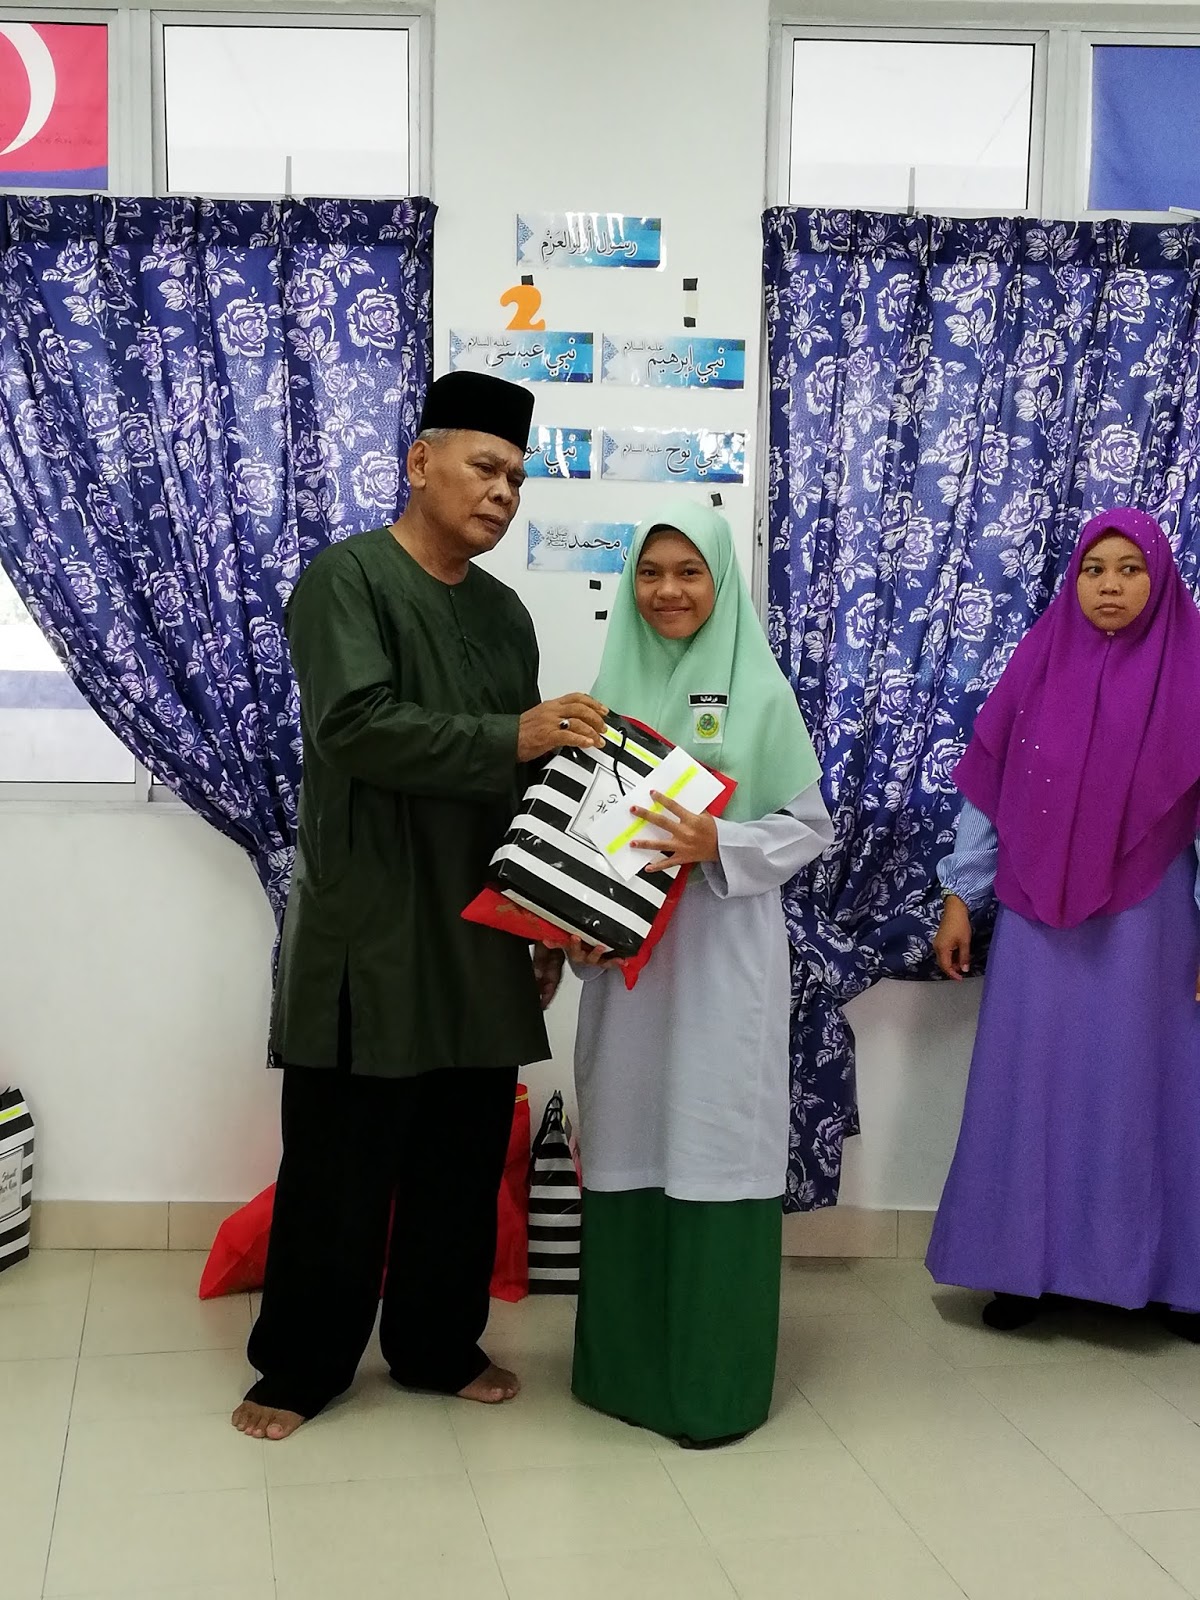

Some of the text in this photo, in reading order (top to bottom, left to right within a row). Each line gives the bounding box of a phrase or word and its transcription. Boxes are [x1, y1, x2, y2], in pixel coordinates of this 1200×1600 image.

[499, 285, 546, 331] 2
[485, 344, 544, 368] عيسى
[546, 338, 576, 376] نبي
[696, 347, 725, 382] نبي
[666, 439, 691, 474] نوح
[568, 535, 621, 549] محمد
